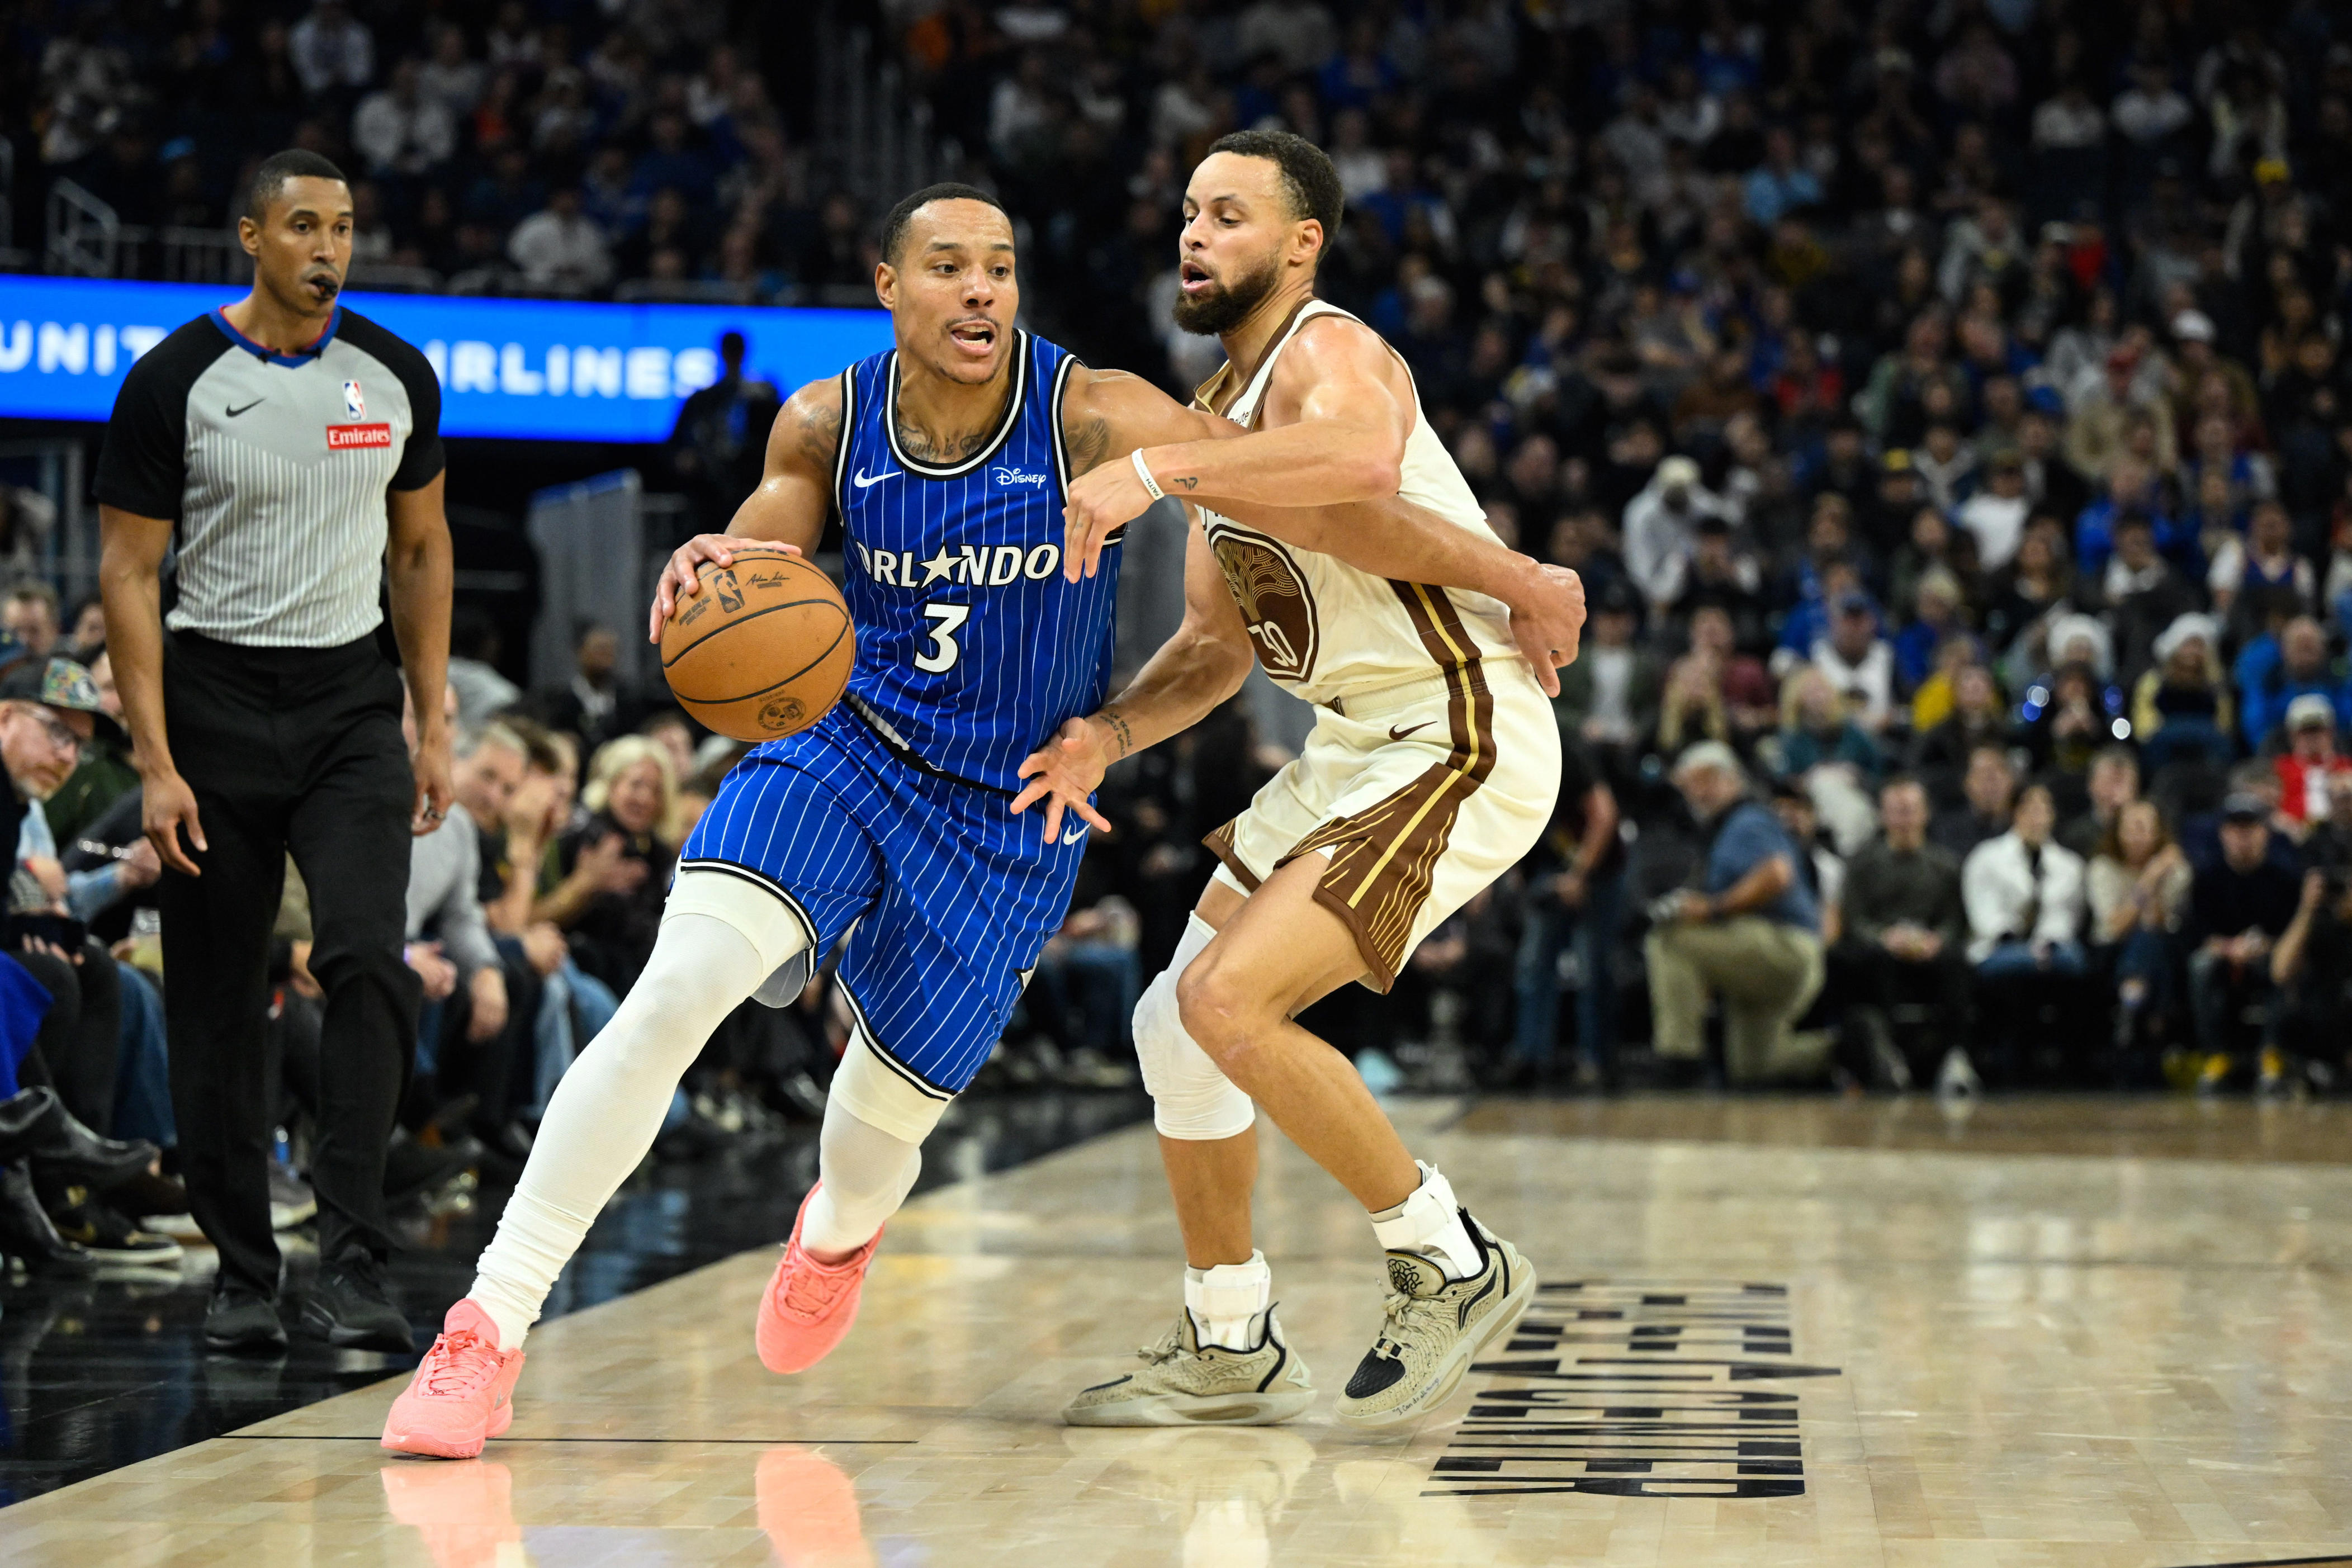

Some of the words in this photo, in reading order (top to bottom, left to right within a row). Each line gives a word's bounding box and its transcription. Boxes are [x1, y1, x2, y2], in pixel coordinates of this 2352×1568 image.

[0, 320, 169, 376] UNIT
[421, 339, 718, 400] IRLINES
[329, 428, 390, 446] Emirates
[993, 467, 1046, 489] Disney
[1146, 479, 1160, 497] FAITH
[914, 603, 971, 674] 3
[1419, 1389, 1806, 1498] CENTER
